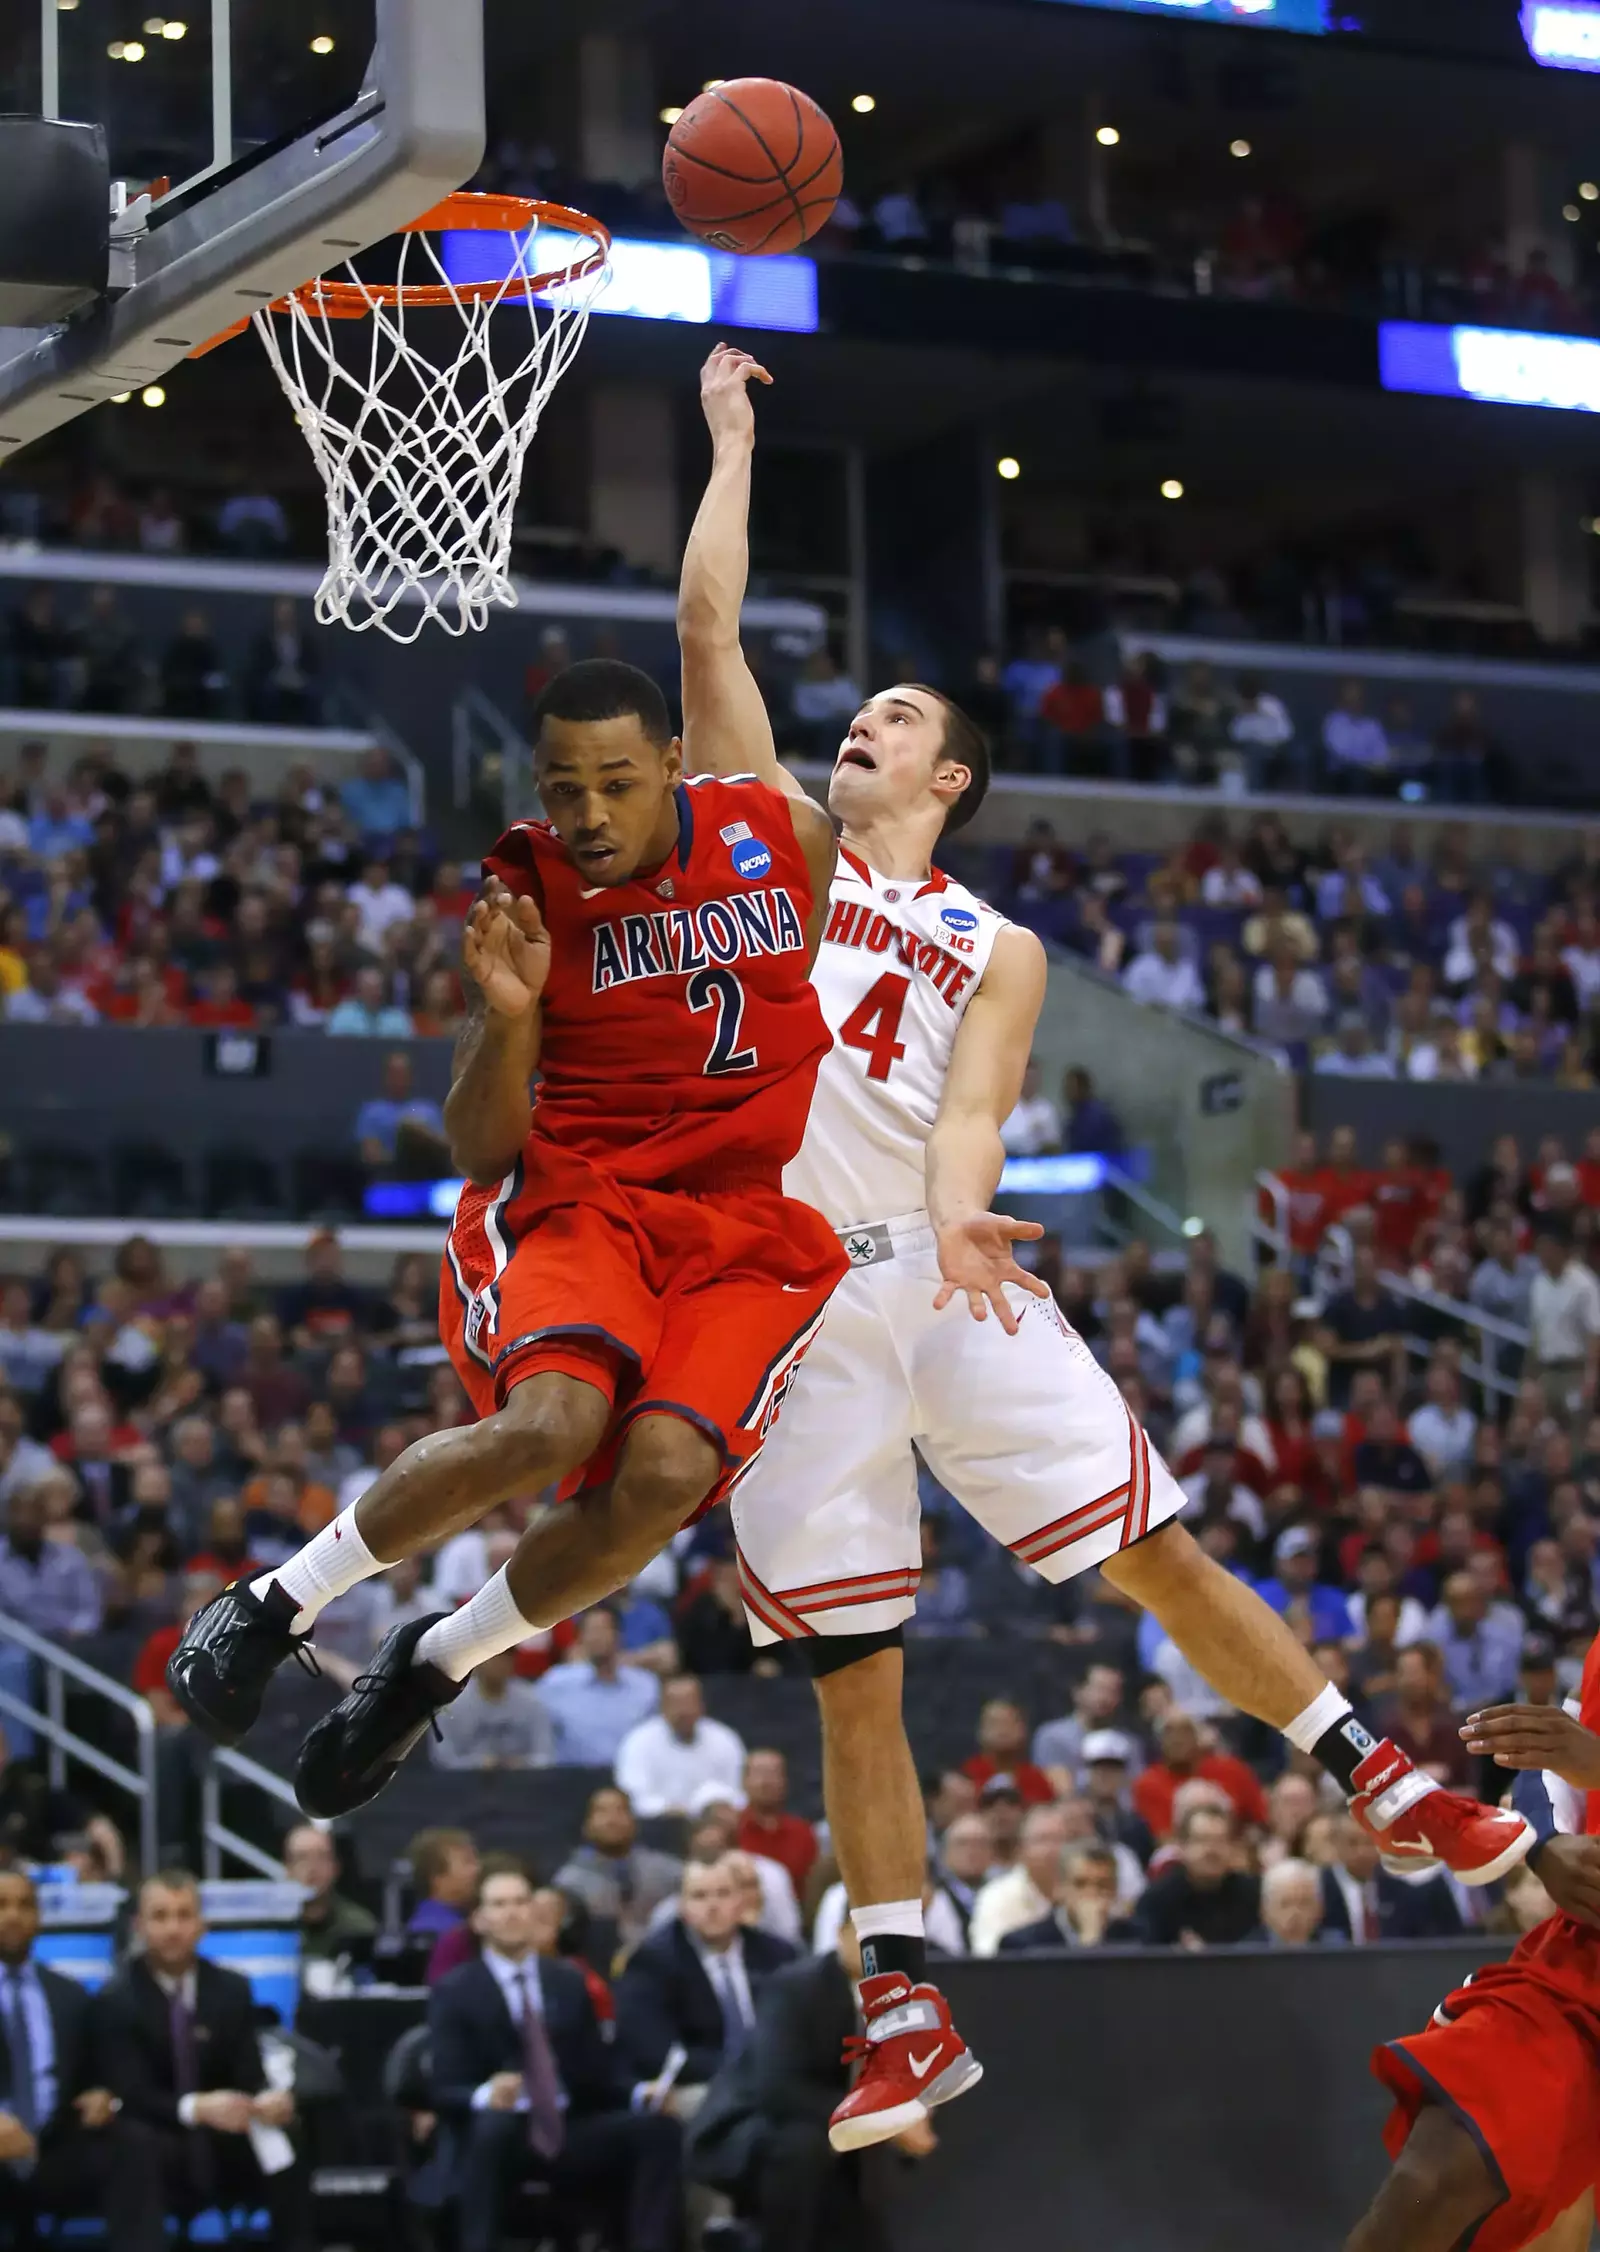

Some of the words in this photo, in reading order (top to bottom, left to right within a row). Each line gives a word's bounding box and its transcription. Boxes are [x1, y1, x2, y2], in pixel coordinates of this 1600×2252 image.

[739, 852, 771, 874] NCAA
[592, 888, 804, 995] ARIZONA
[943, 915, 976, 929] NCAA
[686, 968, 758, 1075] 2
[837, 970, 912, 1084] 4
